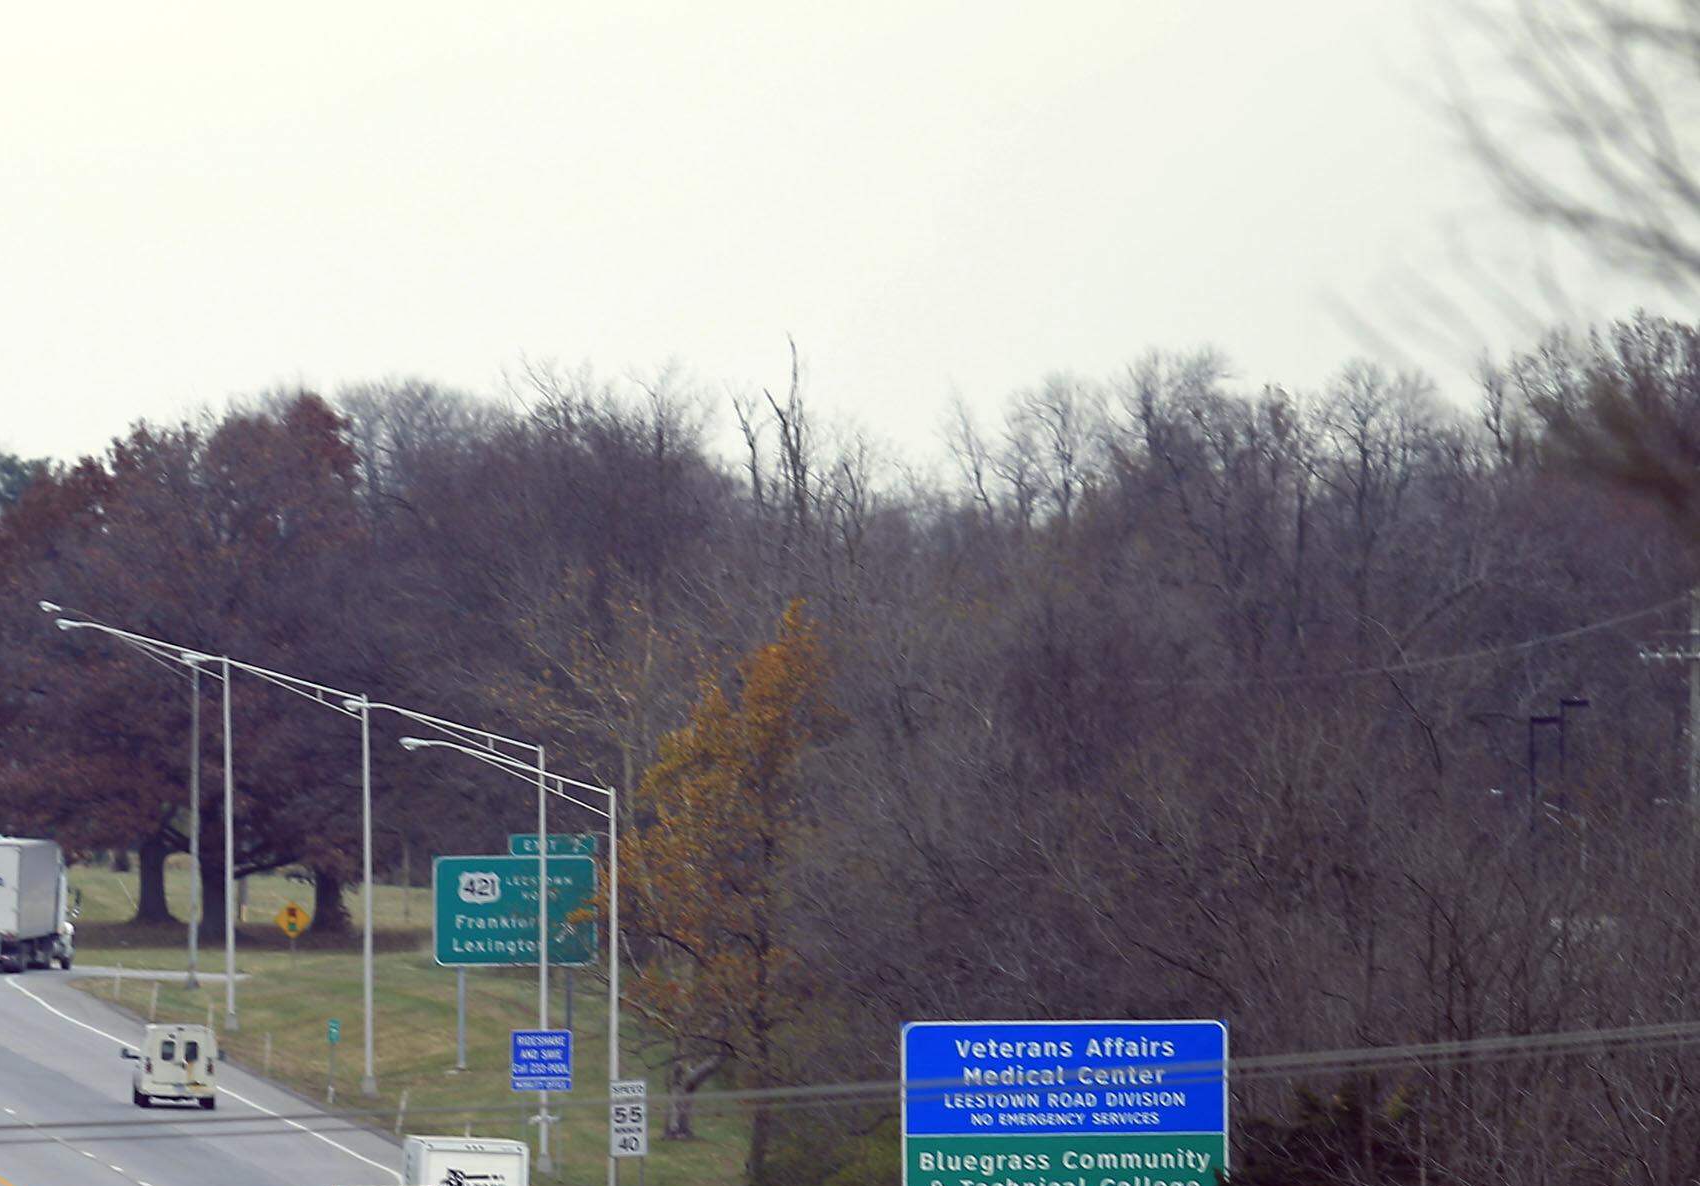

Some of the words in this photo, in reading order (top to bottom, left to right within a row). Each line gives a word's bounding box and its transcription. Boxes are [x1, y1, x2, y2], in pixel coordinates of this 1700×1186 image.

[523, 839, 556, 852] EXT
[464, 877, 496, 897] 421
[454, 914, 547, 930] Frankfor
[452, 937, 547, 958] Lexingto
[955, 1038, 1073, 1059] Veterans
[1086, 1036, 1176, 1058] Affairs
[962, 1064, 1066, 1086] Medical
[1077, 1065, 1167, 1086] Center
[944, 1092, 1040, 1109] LEESTOWN
[1047, 1092, 1098, 1108] ROAD
[1105, 1091, 1187, 1107] DIVISION
[614, 1106, 642, 1124] 55
[970, 1113, 993, 1127] NO
[998, 1112, 1086, 1126] EMERGENCY
[1091, 1112, 1161, 1126] SERVICES
[619, 1136, 640, 1152] 40
[919, 1151, 1051, 1176] Bluegrass
[1062, 1149, 1211, 1173] Community
